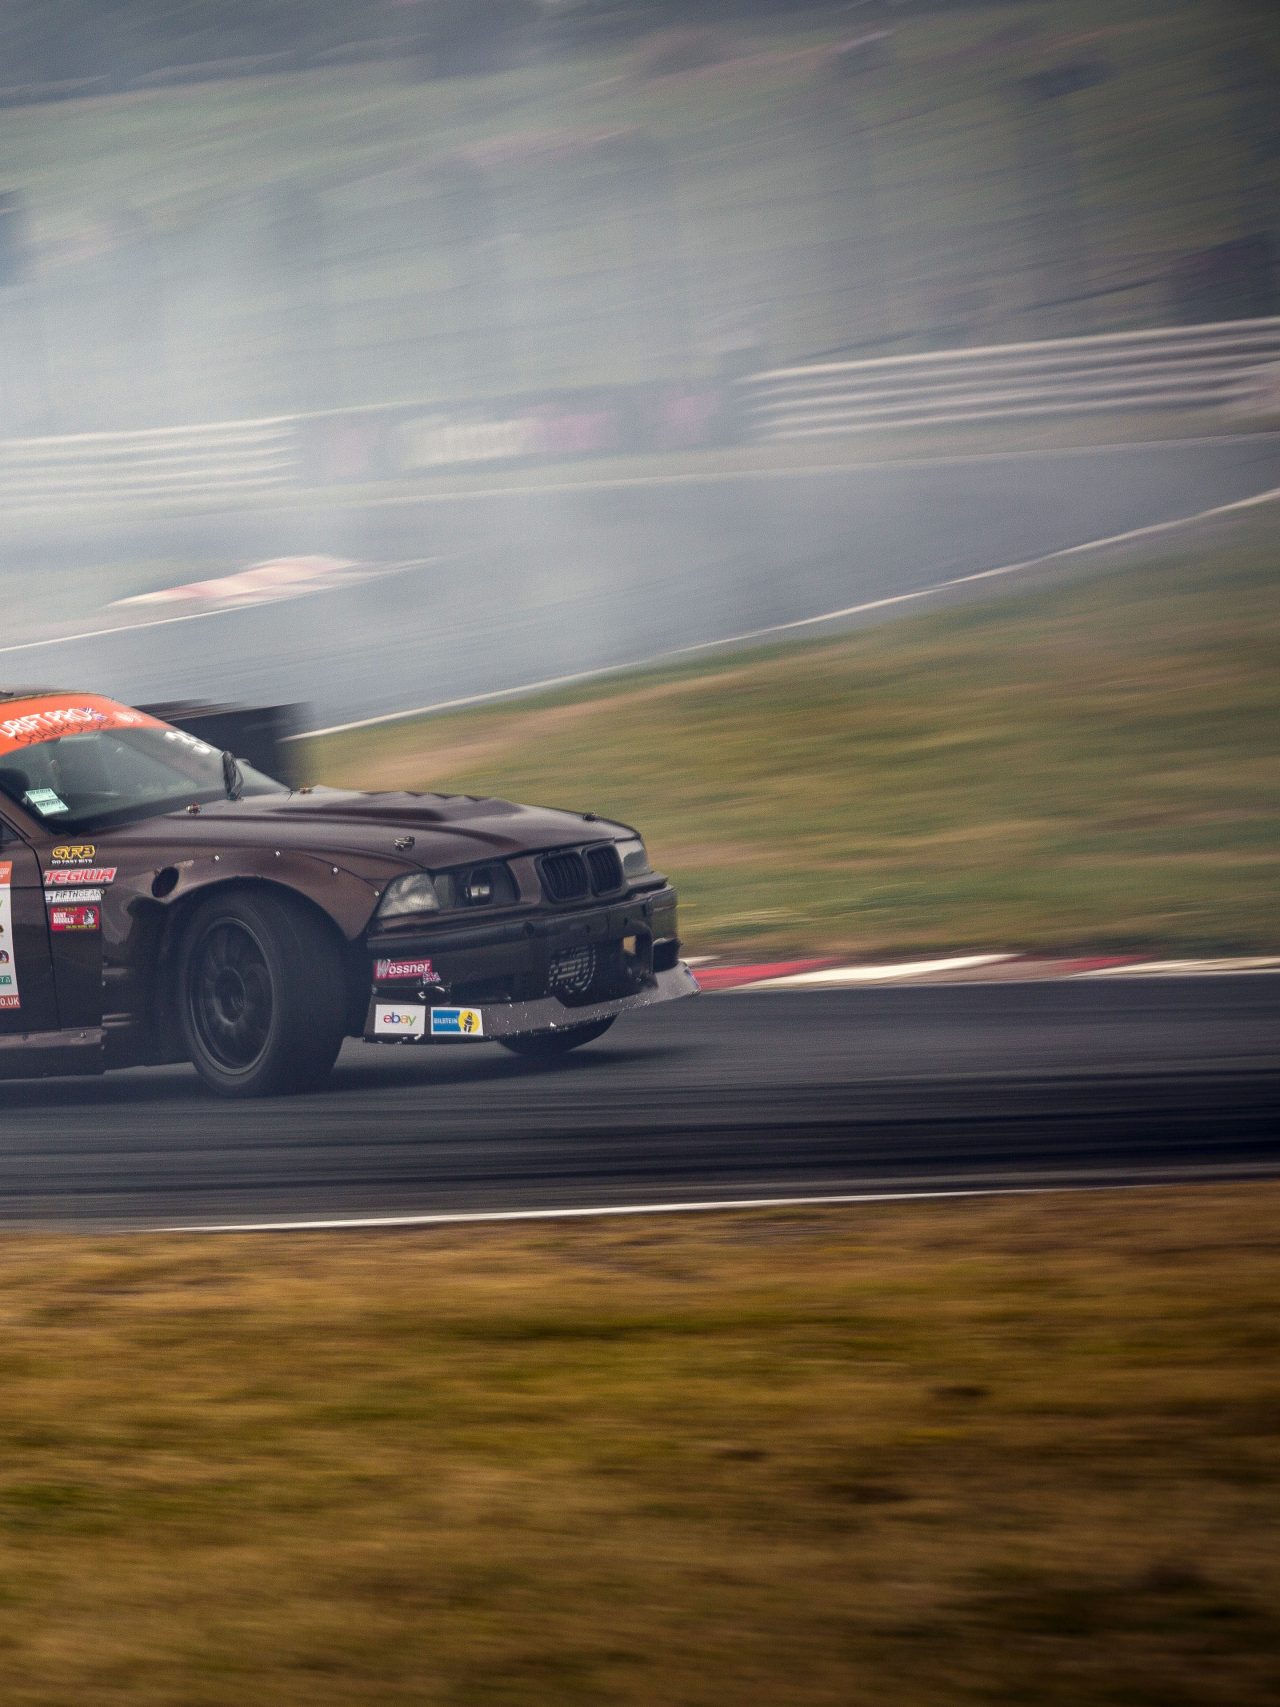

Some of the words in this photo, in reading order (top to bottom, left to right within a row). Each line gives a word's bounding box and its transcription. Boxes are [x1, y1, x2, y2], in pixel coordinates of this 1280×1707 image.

[45, 708, 93, 726] PRO
[45, 868, 116, 885] TEGIWA
[383, 1012, 417, 1026] ebay
[433, 1017, 458, 1025] BILSTEIN
